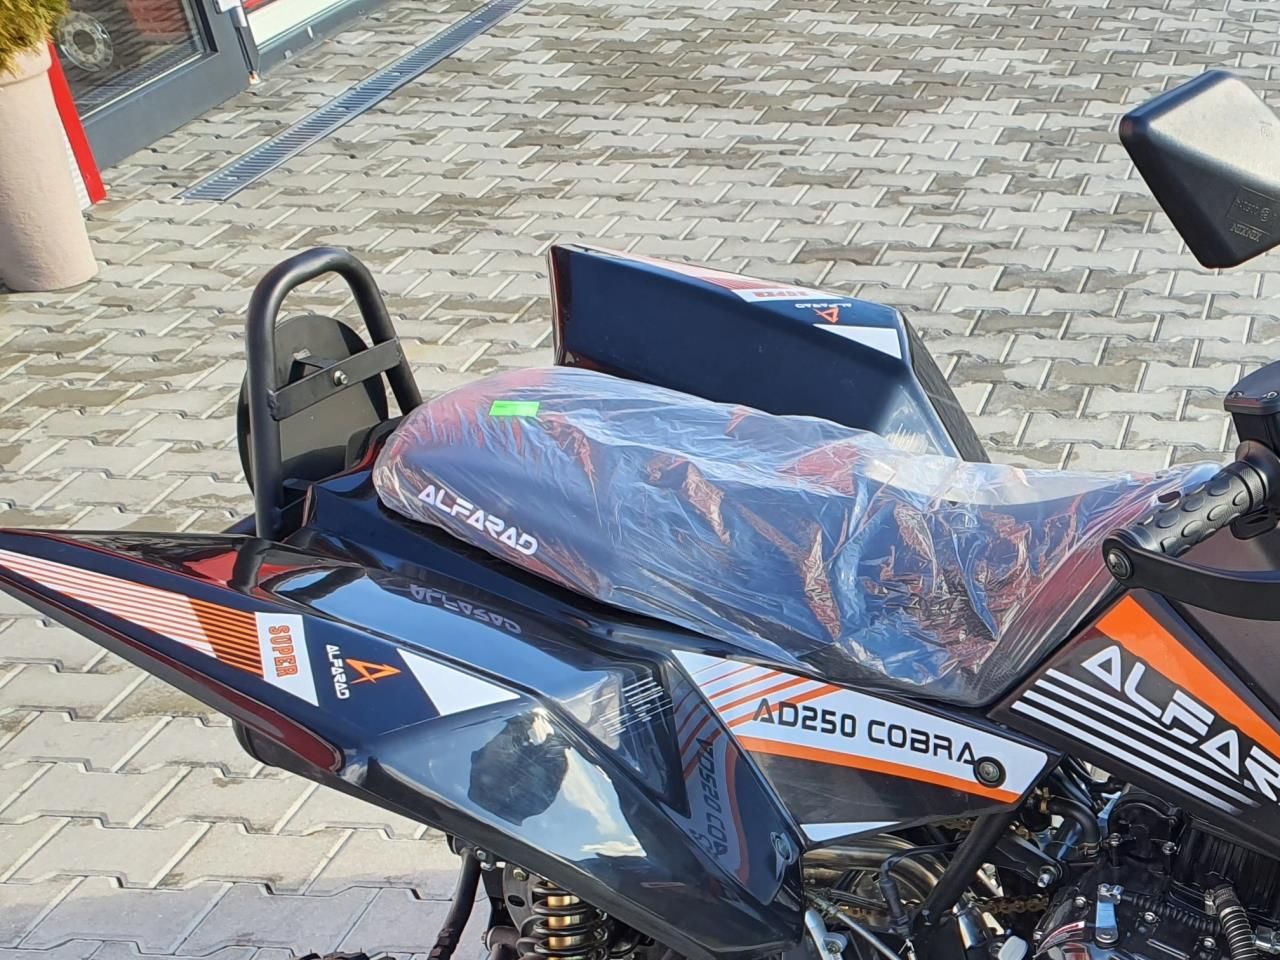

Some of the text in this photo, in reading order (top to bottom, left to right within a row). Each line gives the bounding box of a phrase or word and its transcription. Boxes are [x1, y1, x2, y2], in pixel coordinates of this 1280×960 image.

[418, 484, 538, 556] ALFARAD
[269, 625, 298, 678] SUPER
[326, 644, 350, 699] ALFARAD
[753, 698, 976, 766] AD250 COBRA
